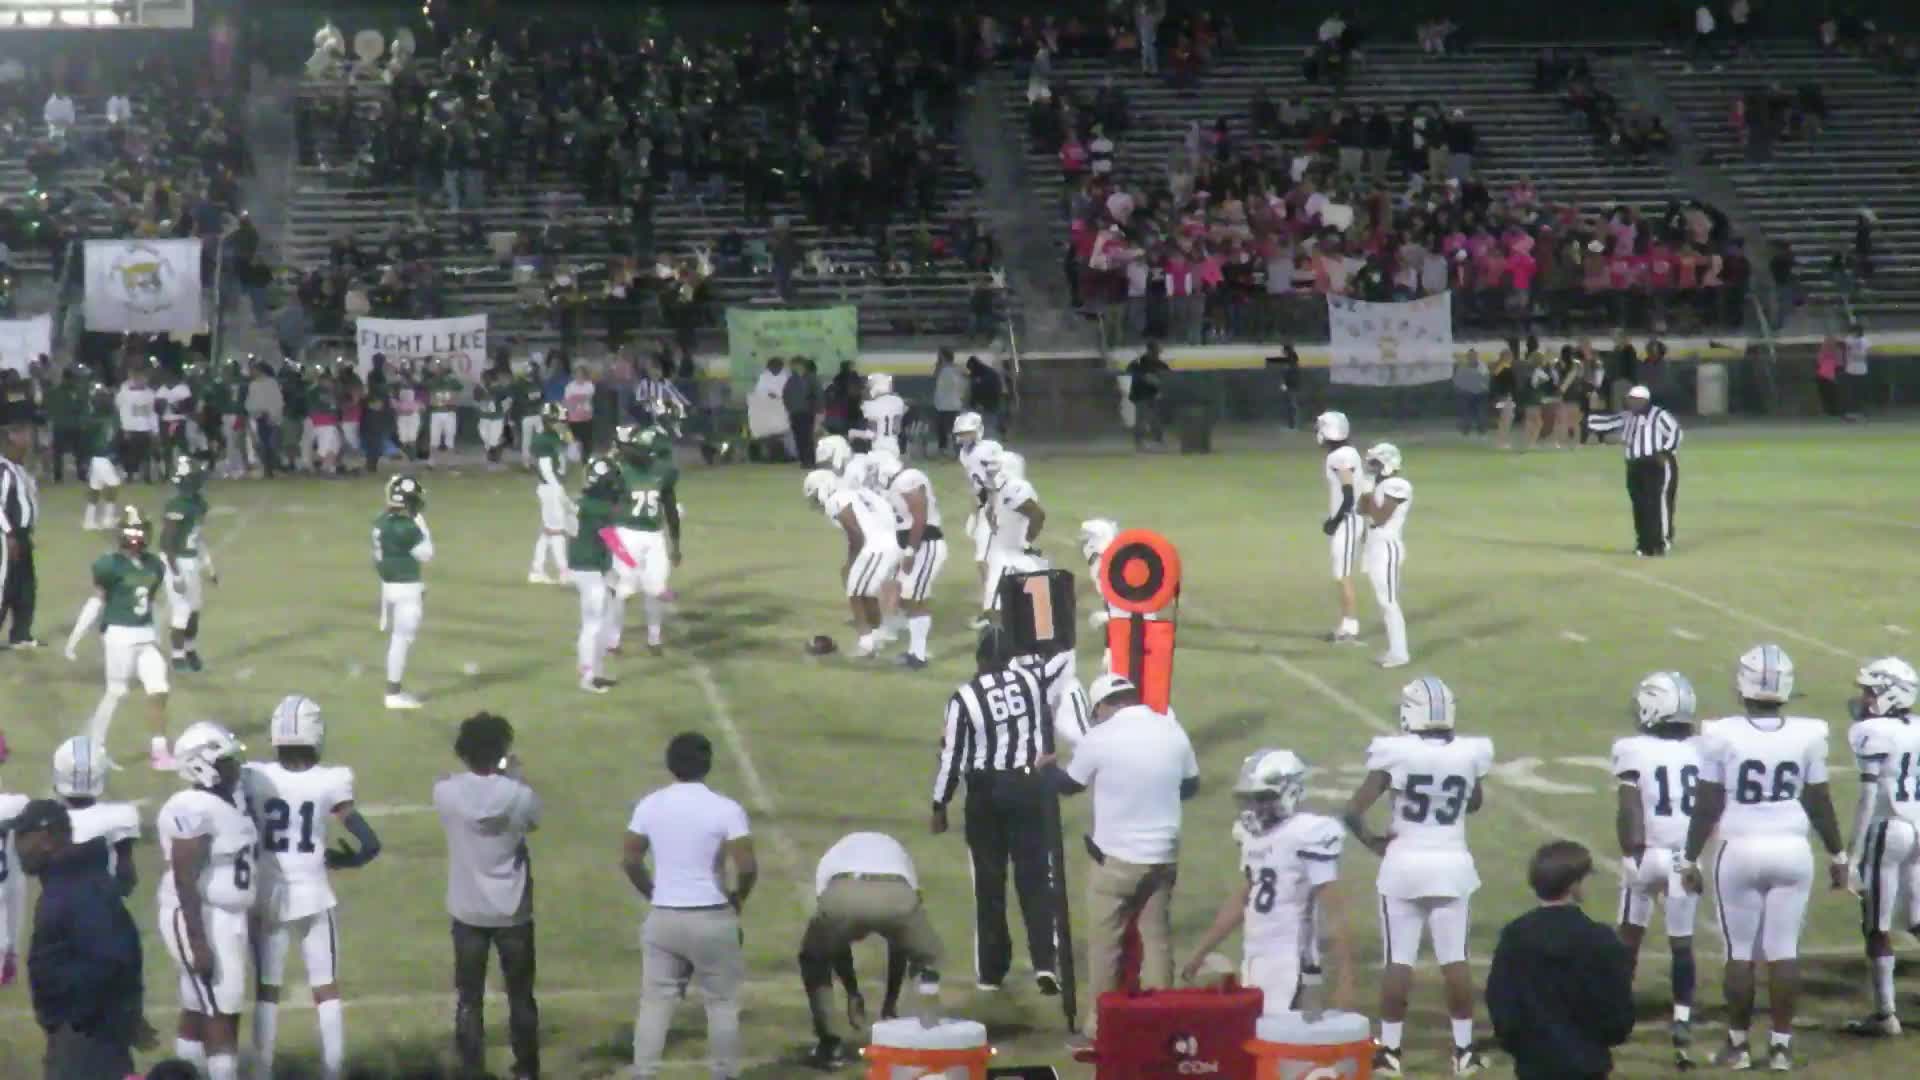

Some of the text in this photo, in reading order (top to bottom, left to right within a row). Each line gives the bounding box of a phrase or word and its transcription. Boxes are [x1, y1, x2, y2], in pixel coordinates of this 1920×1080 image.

[360, 327, 486, 353] FIGHT LIKE
[631, 490, 661, 518] 75
[133, 585, 149, 617] 3
[1022, 574, 1055, 641] 1
[986, 682, 1028, 723] 66
[1402, 773, 1468, 826] 53
[1735, 758, 1800, 805] 66
[263, 797, 316, 854] 21
